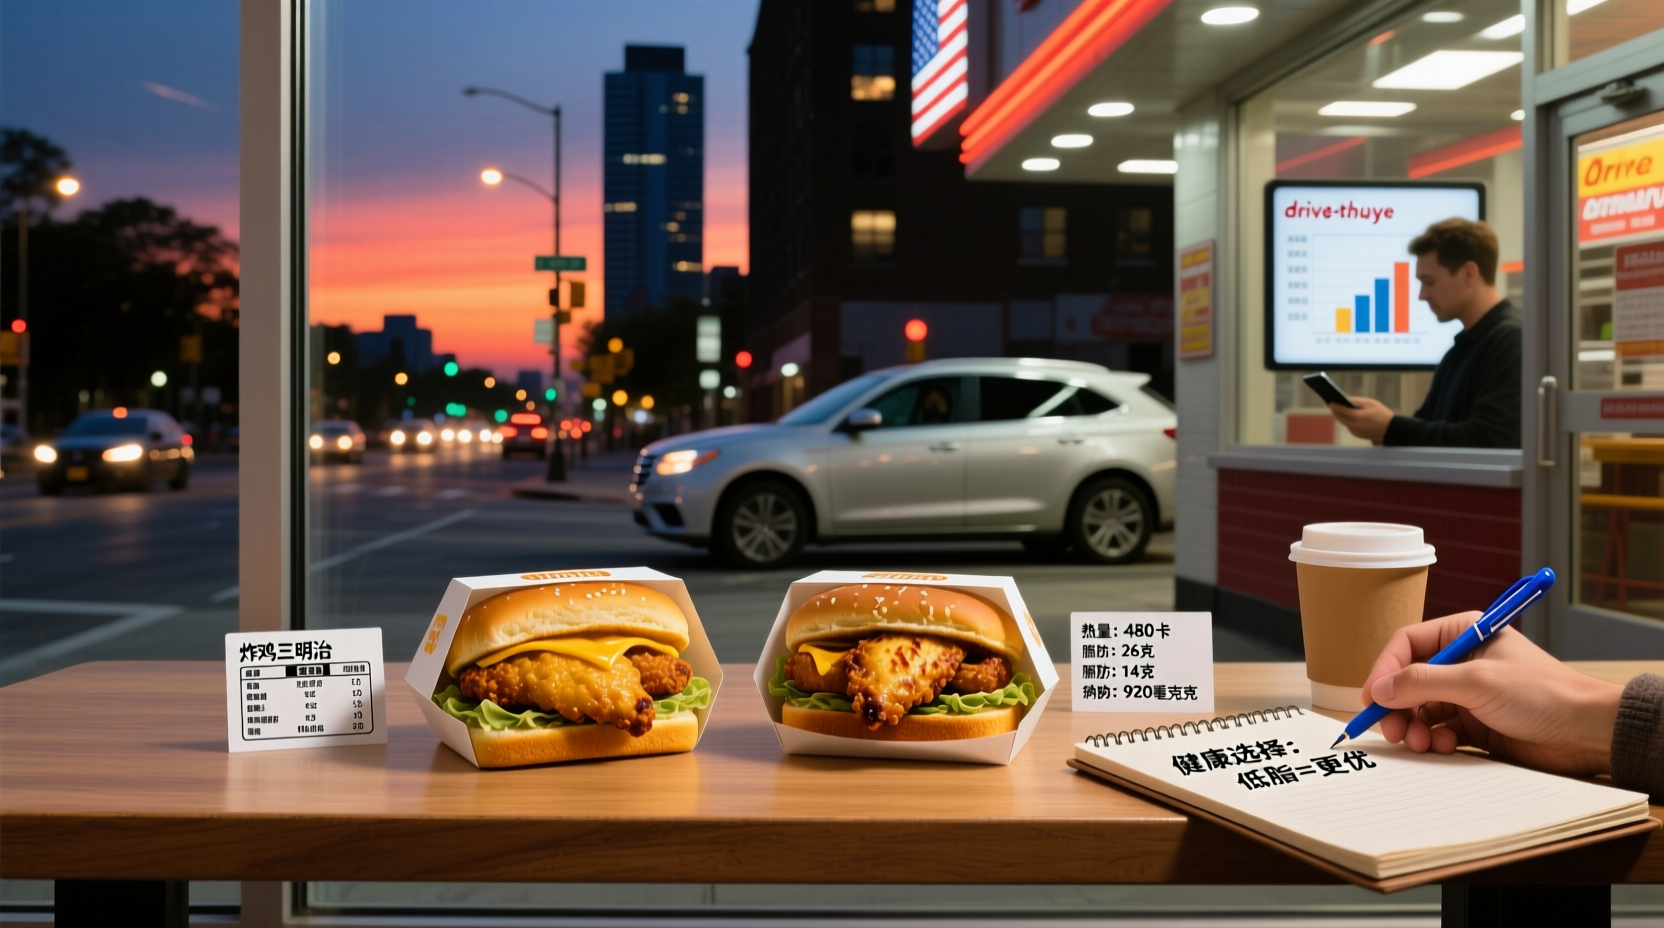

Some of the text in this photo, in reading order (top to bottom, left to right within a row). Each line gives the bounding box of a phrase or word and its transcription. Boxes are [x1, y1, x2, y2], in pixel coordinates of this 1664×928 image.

[1285, 200, 1394, 224] drive-thuye
[1123, 622, 1171, 639] 480卡
[240, 640, 333, 662] 炸鸡三明治
[1121, 643, 1155, 659] 26克
[1121, 663, 1155, 679] 14克
